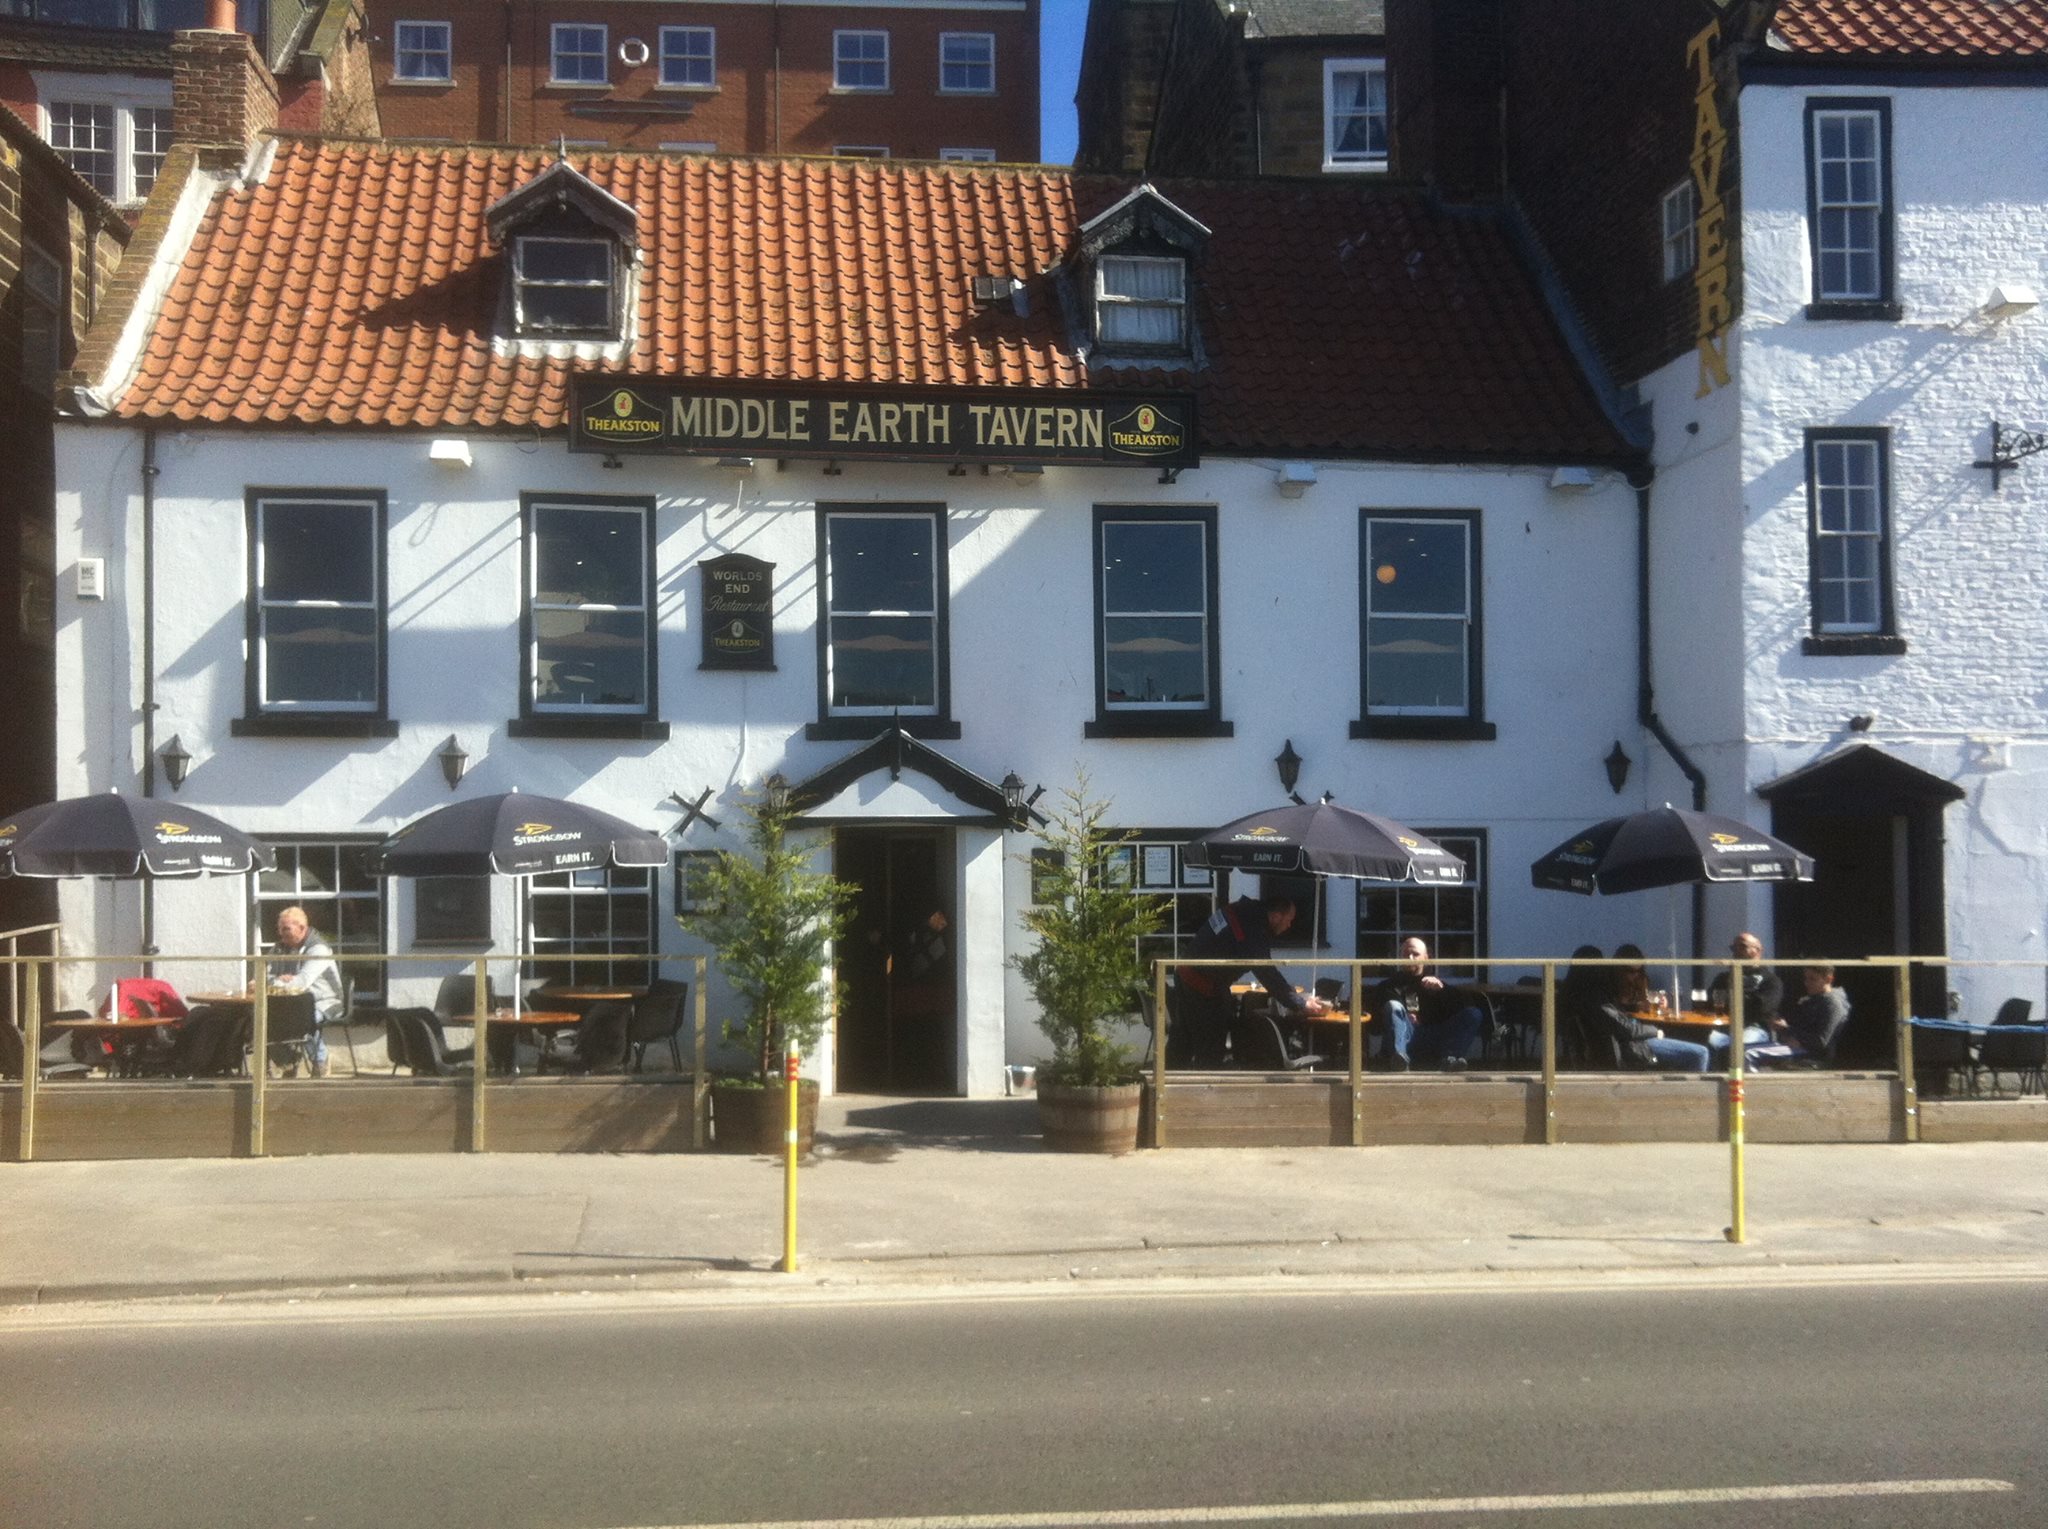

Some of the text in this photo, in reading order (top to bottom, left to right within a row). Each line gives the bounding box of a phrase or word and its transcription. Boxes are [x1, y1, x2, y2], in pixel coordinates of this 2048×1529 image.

[1686, 17, 1732, 399] TAVERN
[586, 416, 660, 433] THEAKSTON
[671, 396, 1104, 448] MIDDLE EARTH TAVERN
[1112, 431, 1181, 447] THEAKSTON
[713, 571, 763, 581] WORLDS
[725, 583, 750, 594] END
[714, 637, 760, 647] THEAKSTON
[555, 853, 580, 865] EARN
